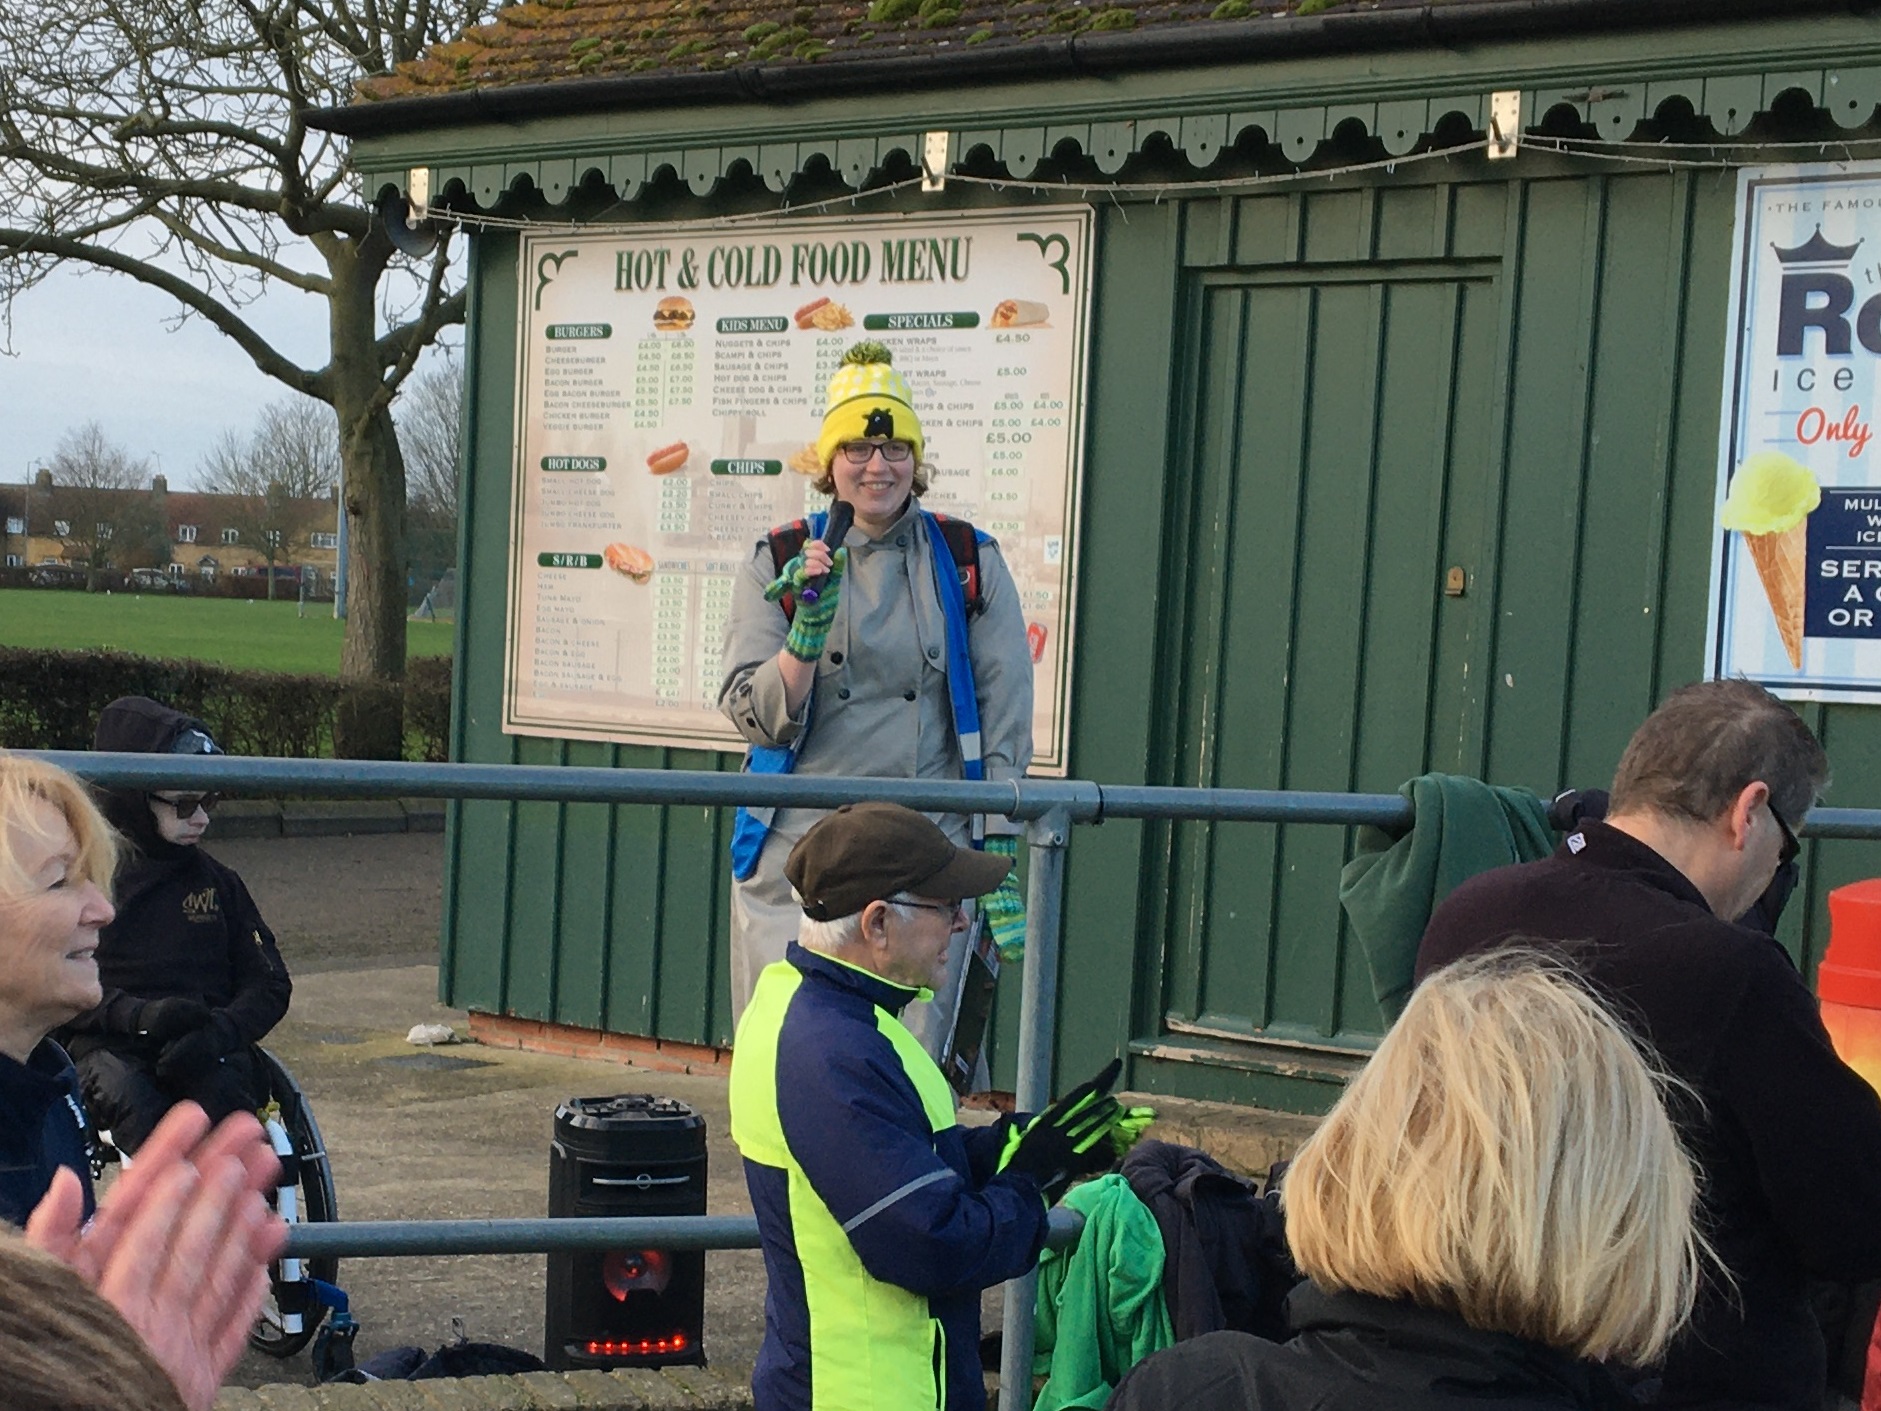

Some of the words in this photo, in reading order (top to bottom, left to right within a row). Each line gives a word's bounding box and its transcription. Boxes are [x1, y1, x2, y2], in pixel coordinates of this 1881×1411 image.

[1776, 202, 1811, 212] THE
[615, 249, 671, 291] HOT
[677, 247, 700, 289] &
[707, 244, 782, 288] COLD
[790, 239, 871, 286] FOOD
[879, 236, 973, 282] MENU
[722, 320, 748, 332] KIDS
[749, 318, 783, 331] MENU
[888, 314, 954, 328] SPECIALS
[554, 326, 603, 338] BURGERS
[715, 340, 754, 348] NUGGETS
[756, 339, 763, 347] &
[766, 339, 791, 347] CHIPS
[816, 337, 844, 346] £4.00
[906, 337, 937, 345] WRAPS
[996, 333, 1030, 343] £4.50
[714, 351, 745, 359] SCAMPI
[748, 350, 754, 359] &
[757, 351, 783, 359] CHIPS
[816, 349, 843, 358] £4.00
[714, 362, 752, 370] SAUSAGE
[754, 361, 761, 370] &
[764, 362, 789, 370] CHIPS
[997, 367, 1027, 376] £5.00
[544, 379, 570, 387] BACON
[670, 375, 693, 383] £7.00
[714, 374, 731, 382] HOT
[733, 374, 750, 382] DOG
[753, 373, 759, 382] &
[713, 385, 745, 393] CHEESE
[768, 385, 775, 393] &
[777, 385, 802, 393] CHIPS
[544, 401, 569, 409] BACON
[713, 397, 732, 405] FISH
[735, 397, 770, 405] FINGERS
[773, 396, 779, 405] &
[782, 397, 808, 405] CHIPS
[937, 402, 944, 410] &
[947, 402, 974, 410] CHIPS
[994, 401, 1024, 410] £5.00
[1033, 401, 1063, 409] £4.00
[712, 409, 742, 417] CHIPPY
[745, 409, 767, 417] ROLL
[946, 419, 953, 427] &
[992, 419, 1021, 428] £5.00
[1031, 418, 1061, 426] £4.00
[1797, 404, 1873, 458] Only
[986, 432, 1032, 444] £5.00
[993, 451, 1023, 460] £5.00
[548, 458, 570, 470] HOT
[571, 458, 600, 470] DOGS
[728, 461, 765, 474] CHIPS
[738, 491, 763, 499] CHIPS
[708, 502, 737, 510] CURRY
[739, 502, 746, 510] &
[749, 503, 773, 511] CHIPS
[552, 554, 588, 567] S/R/B
[1843, 584, 1864, 602] A
[1828, 608, 1874, 627] OR
